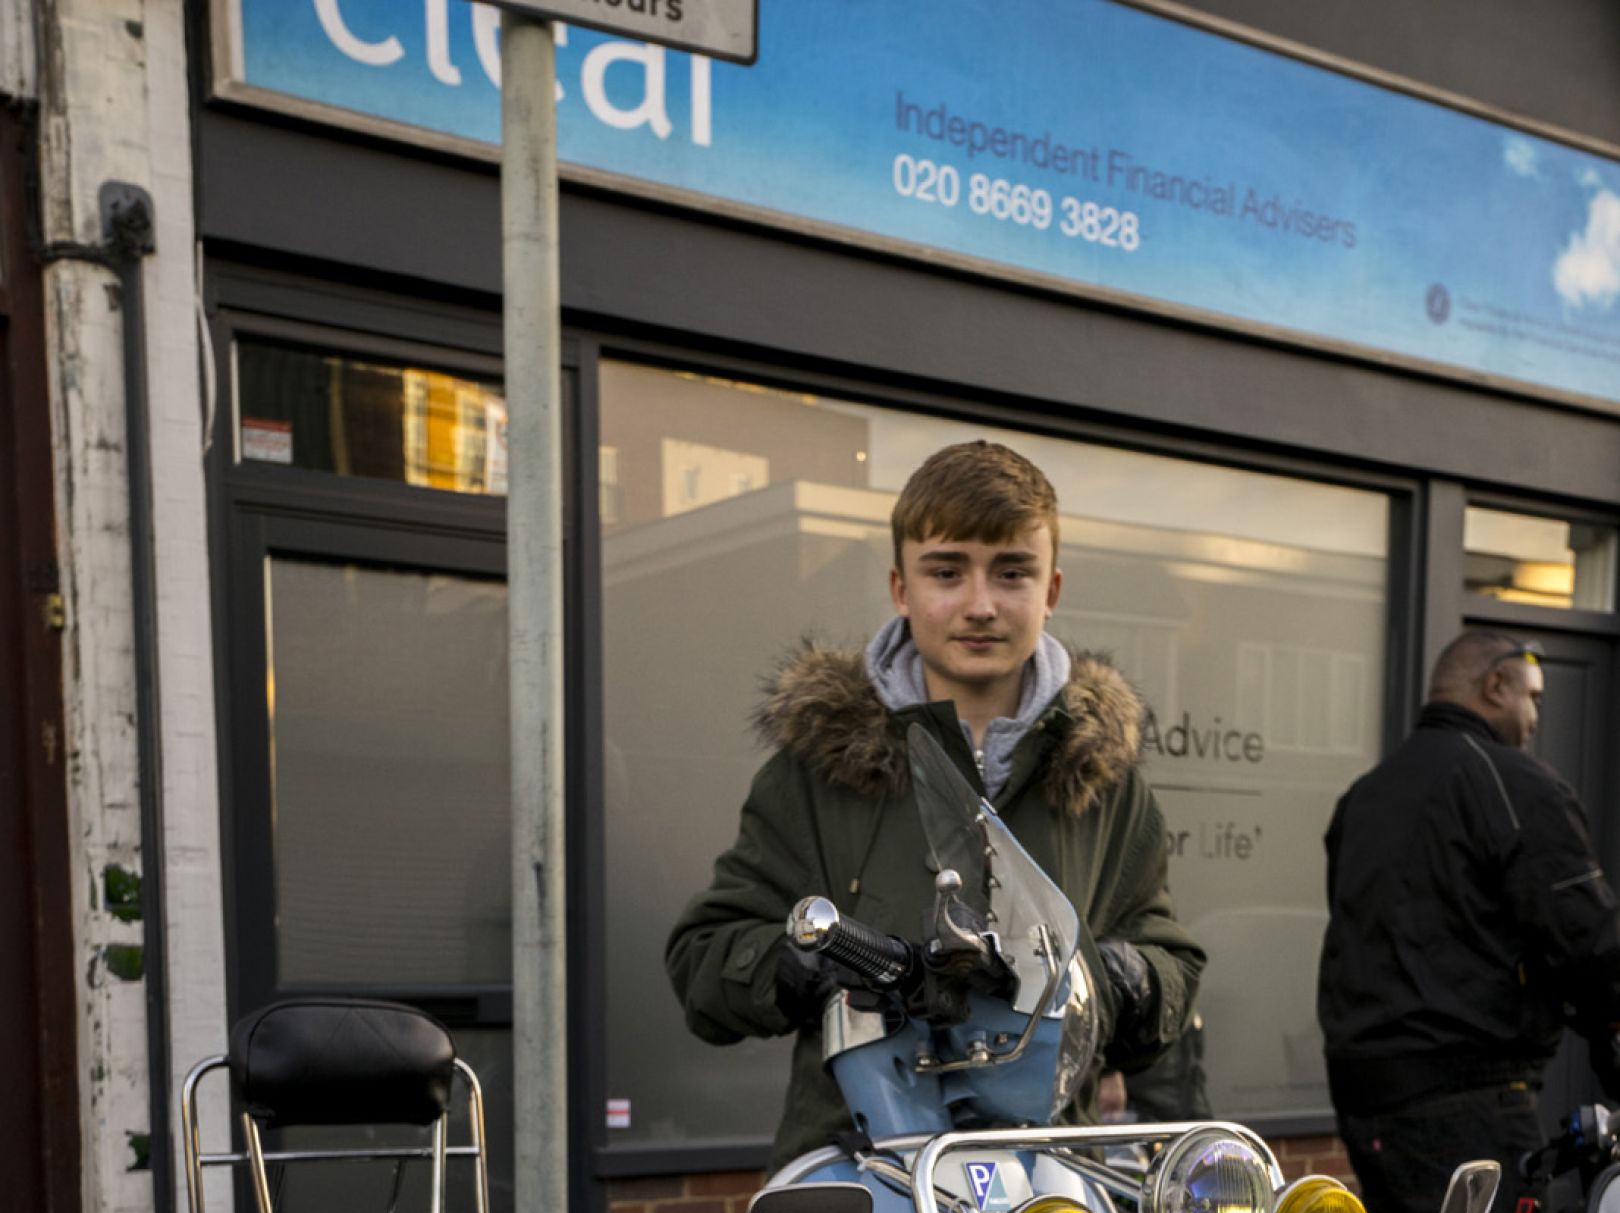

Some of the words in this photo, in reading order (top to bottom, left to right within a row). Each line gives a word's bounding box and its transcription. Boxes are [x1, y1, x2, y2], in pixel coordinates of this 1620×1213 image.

[592, 0, 683, 21] urs
[895, 91, 1101, 183] Independent
[1107, 150, 1236, 217] Financial
[1239, 187, 1358, 249] Advisers
[893, 153, 960, 207] 020
[968, 173, 1053, 230] 8669
[1060, 196, 1140, 252] 3828
[1139, 708, 1265, 763] Advice
[968, 1165, 990, 1196] P
